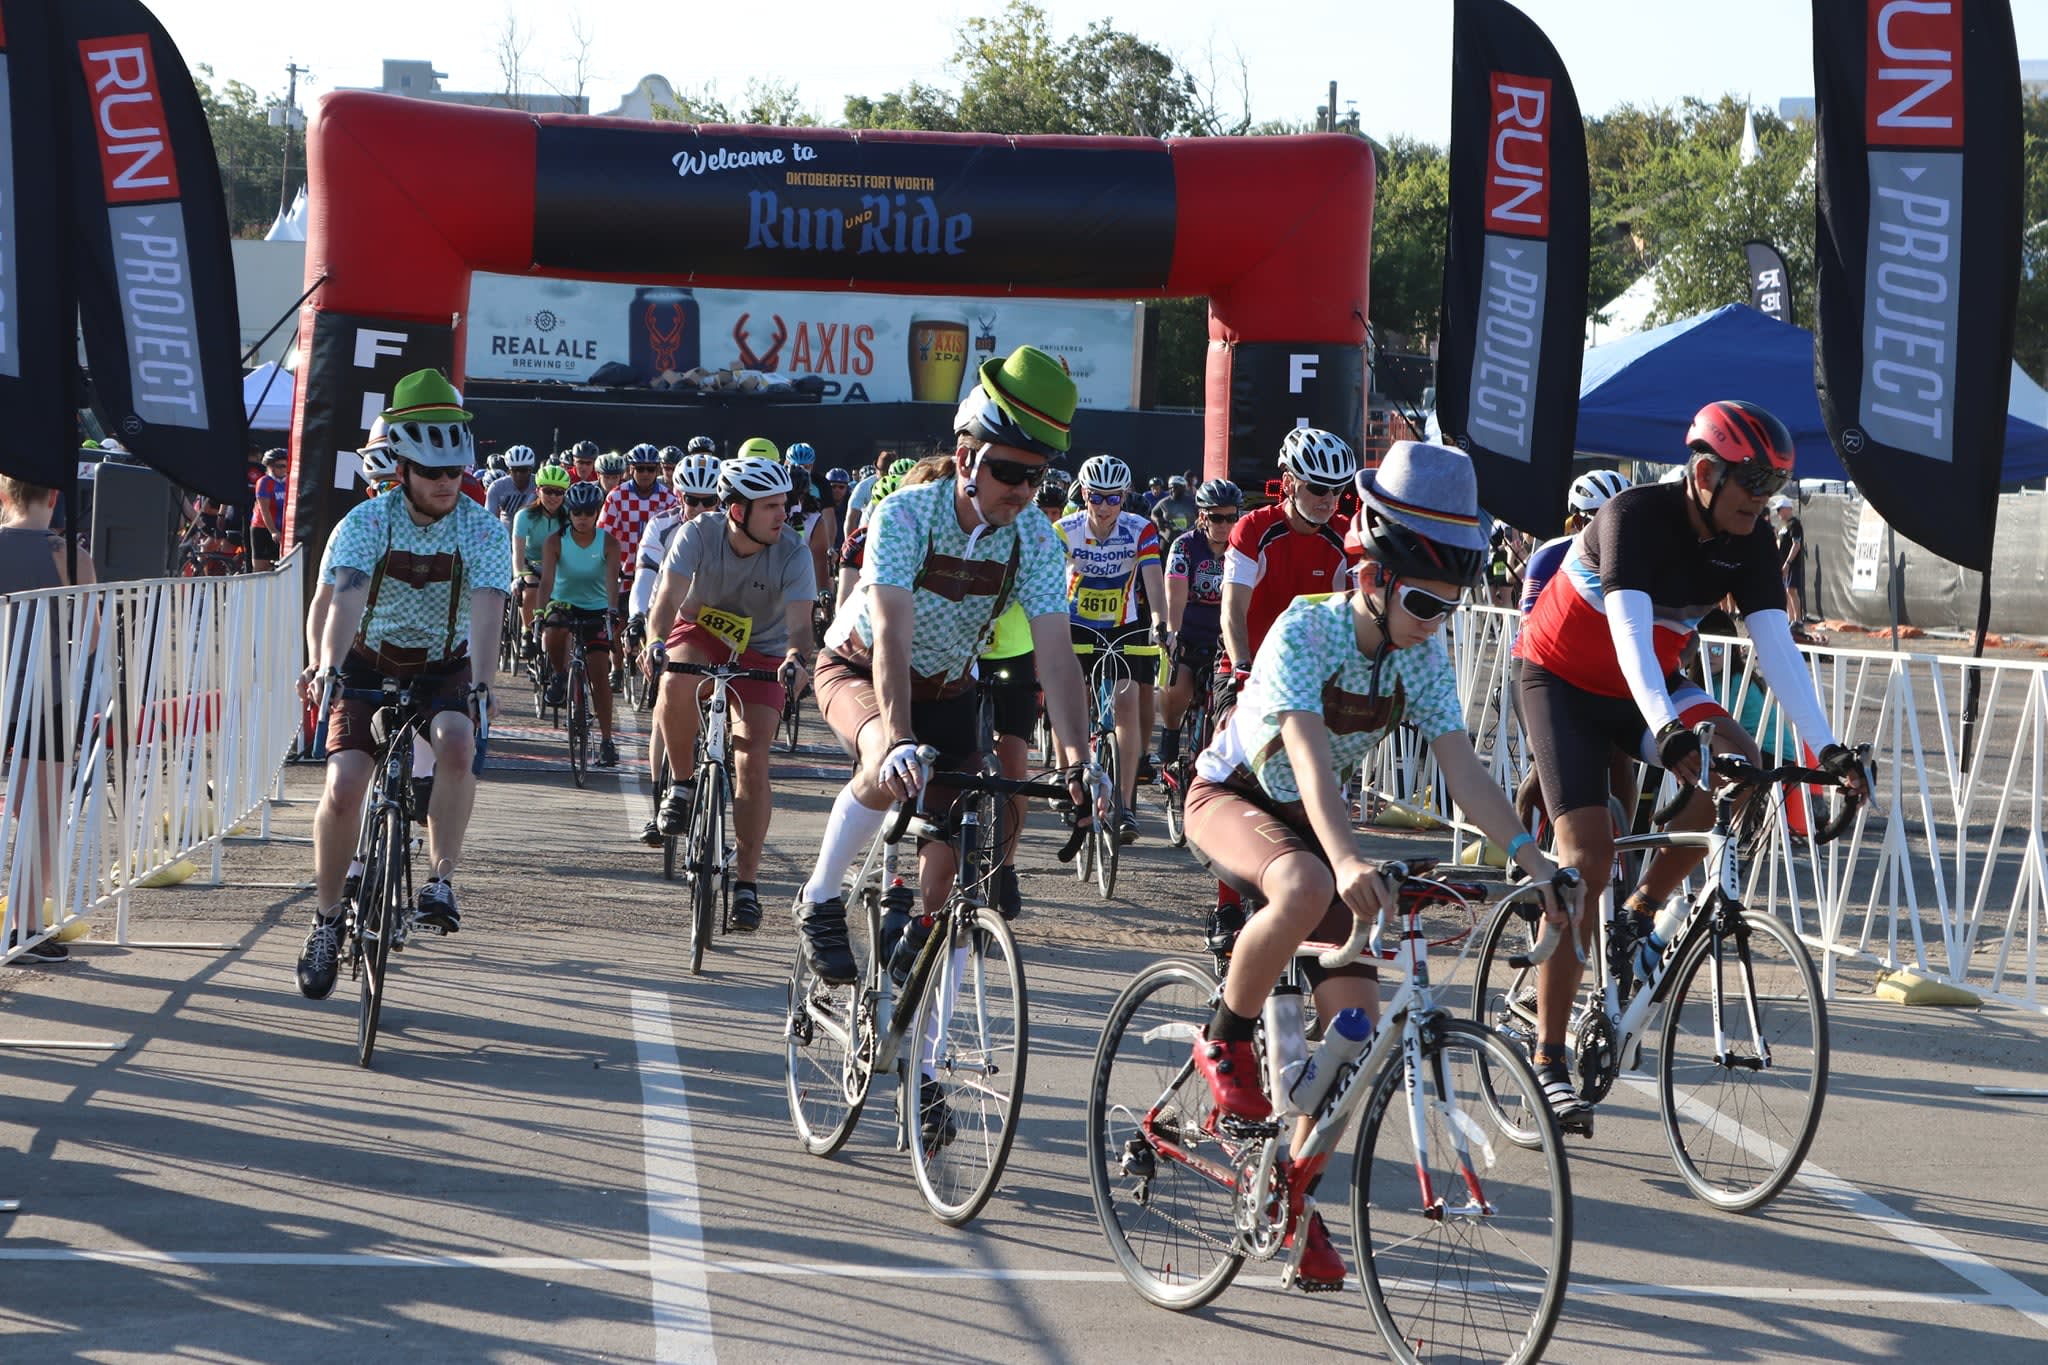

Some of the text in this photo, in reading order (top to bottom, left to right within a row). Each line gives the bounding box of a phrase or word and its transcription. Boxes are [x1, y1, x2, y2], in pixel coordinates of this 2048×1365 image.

[87, 47, 169, 189] RUN
[671, 143, 818, 177] Welcome to
[1492, 84, 1545, 224] RUN
[786, 171, 935, 191] OKTOBERFEST FORT WORTH
[744, 189, 973, 255] Run UND Ride
[120, 231, 198, 414] PROJECT
[1872, 186, 1950, 440] PROJECT
[492, 335, 598, 361] REAL ALE
[788, 321, 875, 376] AXIS
[934, 352, 961, 362] IPA
[935, 333, 963, 353] AXIS
[1475, 260, 1538, 447] PROJECT
[512, 358, 562, 369] BREWING
[1072, 547, 1135, 562] Panasonic
[1080, 597, 1118, 613] 4610
[701, 614, 745, 643] 4874
